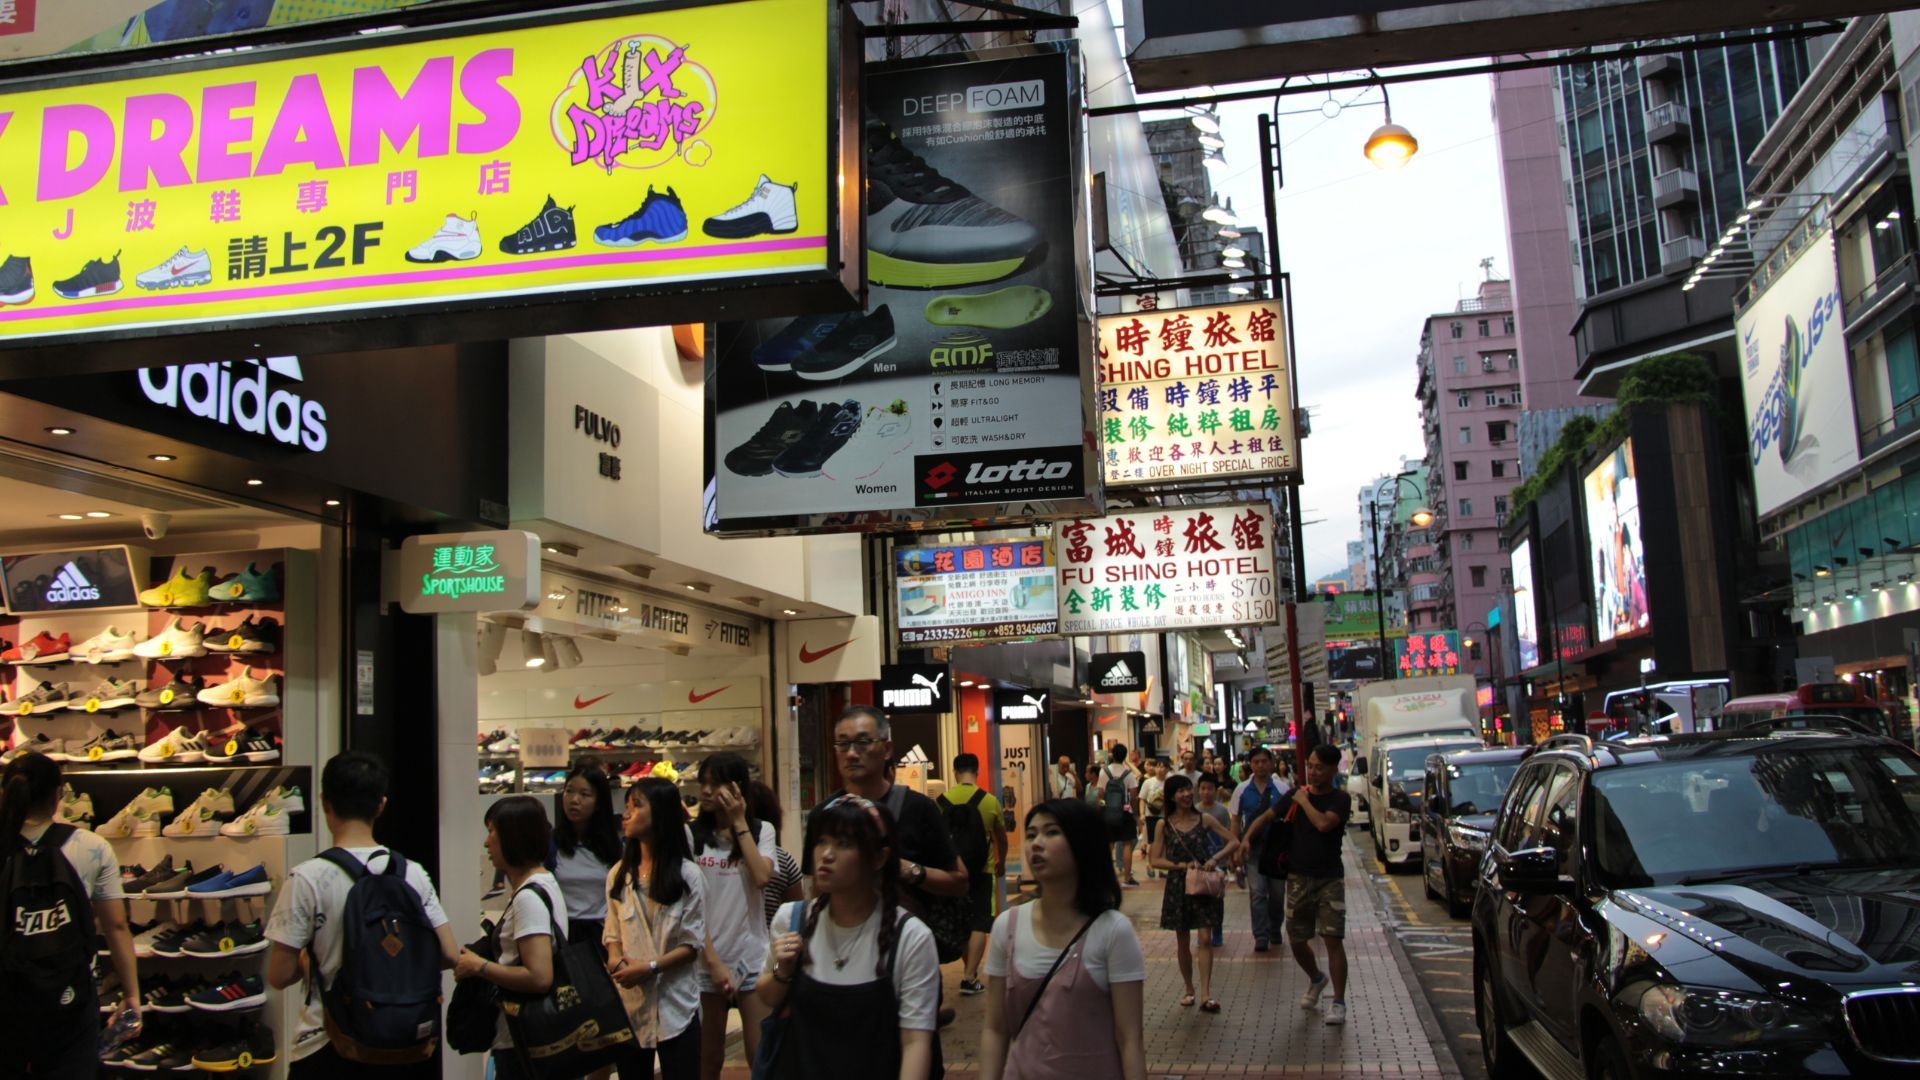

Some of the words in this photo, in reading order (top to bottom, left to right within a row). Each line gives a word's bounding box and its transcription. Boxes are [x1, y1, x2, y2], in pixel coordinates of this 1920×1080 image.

[903, 93, 964, 116] DEEP
[971, 84, 1040, 109] FOAM
[36, 48, 521, 204] DREAMS
[227, 221, 384, 281] 請上2F
[873, 362, 897, 374] Men
[1185, 349, 1279, 376] HOTEL
[989, 378, 1010, 387] LONG
[1012, 375, 1046, 386] MEMORY
[1165, 373, 1279, 408] 時鐘特平
[138, 359, 328, 453] adidas
[970, 397, 1000, 407] FIT&GO
[574, 403, 621, 449] FULVO
[971, 414, 1019, 425] ULTRALIGHT
[1104, 414, 1155, 444] 裝修
[1167, 404, 1281, 438] 純粹租房
[981, 432, 1027, 443] WASH&DRY
[965, 458, 1073, 484] lotto
[1149, 464, 1175, 478] OVER
[1180, 462, 1208, 475] NIGHT
[1213, 457, 1255, 473] SPECIAL
[1261, 455, 1290, 468] PRICE
[855, 484, 897, 495] Women
[965, 489, 1000, 497] ITALIAN
[1004, 486, 1034, 494] SPORT
[1038, 484, 1074, 493] DESIGN
[432, 544, 494, 568] 運動家
[934, 545, 1043, 573] 花園酒店
[1062, 567, 1094, 586] FU
[1105, 562, 1177, 583] SHING
[1187, 557, 1269, 577] HOTEL
[46, 585, 101, 602] adidas
[949, 588, 985, 600] AMIGO
[987, 587, 1007, 598] INN
[1175, 581, 1217, 593] 二小時
[1231, 576, 1271, 598] $70
[1064, 583, 1167, 614] 全新裝修
[652, 606, 689, 635] FITTER
[1232, 599, 1274, 621] $150
[923, 627, 972, 641] 23325226
[993, 625, 1015, 636] +852
[1016, 621, 1057, 635] 93456037
[1064, 619, 1096, 632] SPECIAL
[1100, 617, 1122, 629] PRICE
[1128, 616, 1151, 627] WHOLE
[1154, 615, 1167, 626] DAY
[720, 622, 751, 648] FITTER
[1101, 674, 1139, 687] adidas
[883, 688, 932, 708] PUMA
[1001, 705, 1038, 719] PUMA
[1004, 747, 1031, 759] JUST
